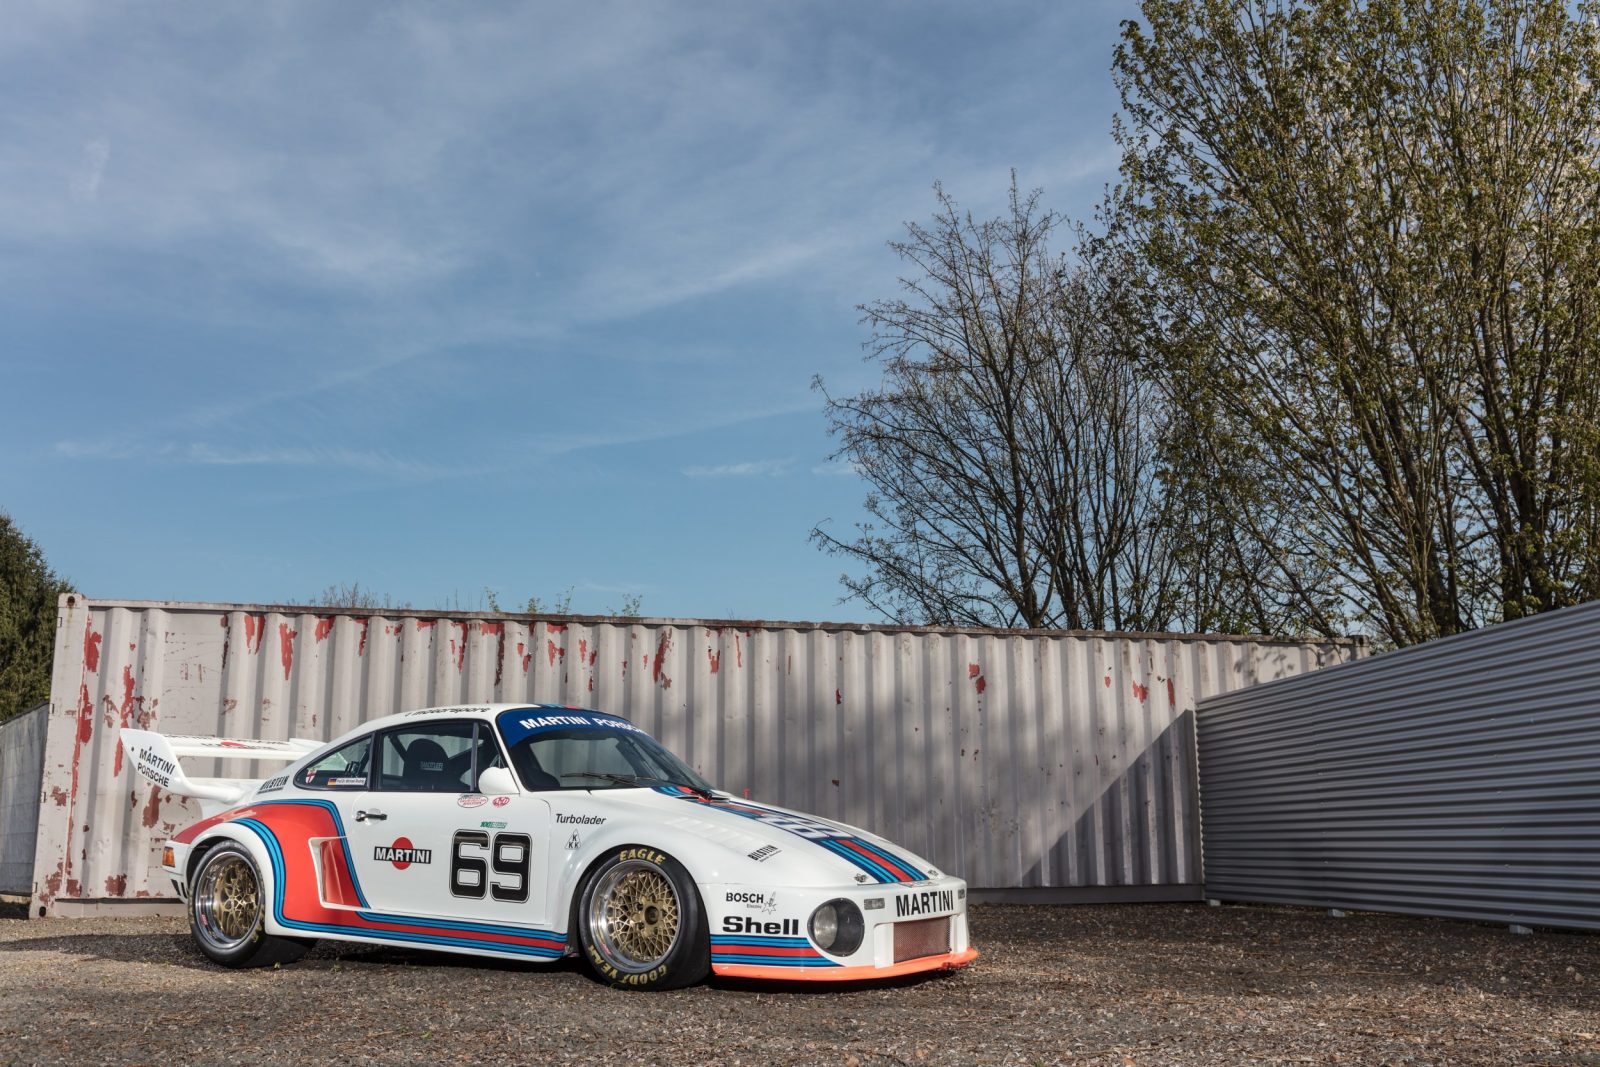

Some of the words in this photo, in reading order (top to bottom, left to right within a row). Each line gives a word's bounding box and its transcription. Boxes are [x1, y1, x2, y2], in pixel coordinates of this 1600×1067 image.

[518, 715, 592, 730] MARTINI
[139, 748, 176, 775] MARTINI
[137, 762, 170, 788] PORSCHE
[555, 813, 607, 825] Turbolader
[375, 847, 431, 863] MARTINI
[619, 848, 666, 866] EAGLE
[449, 828, 533, 904] 69
[725, 891, 765, 904] BOSCH
[895, 889, 954, 918] MARTINI
[722, 915, 800, 936] Shell
[629, 964, 668, 985] GOOD
